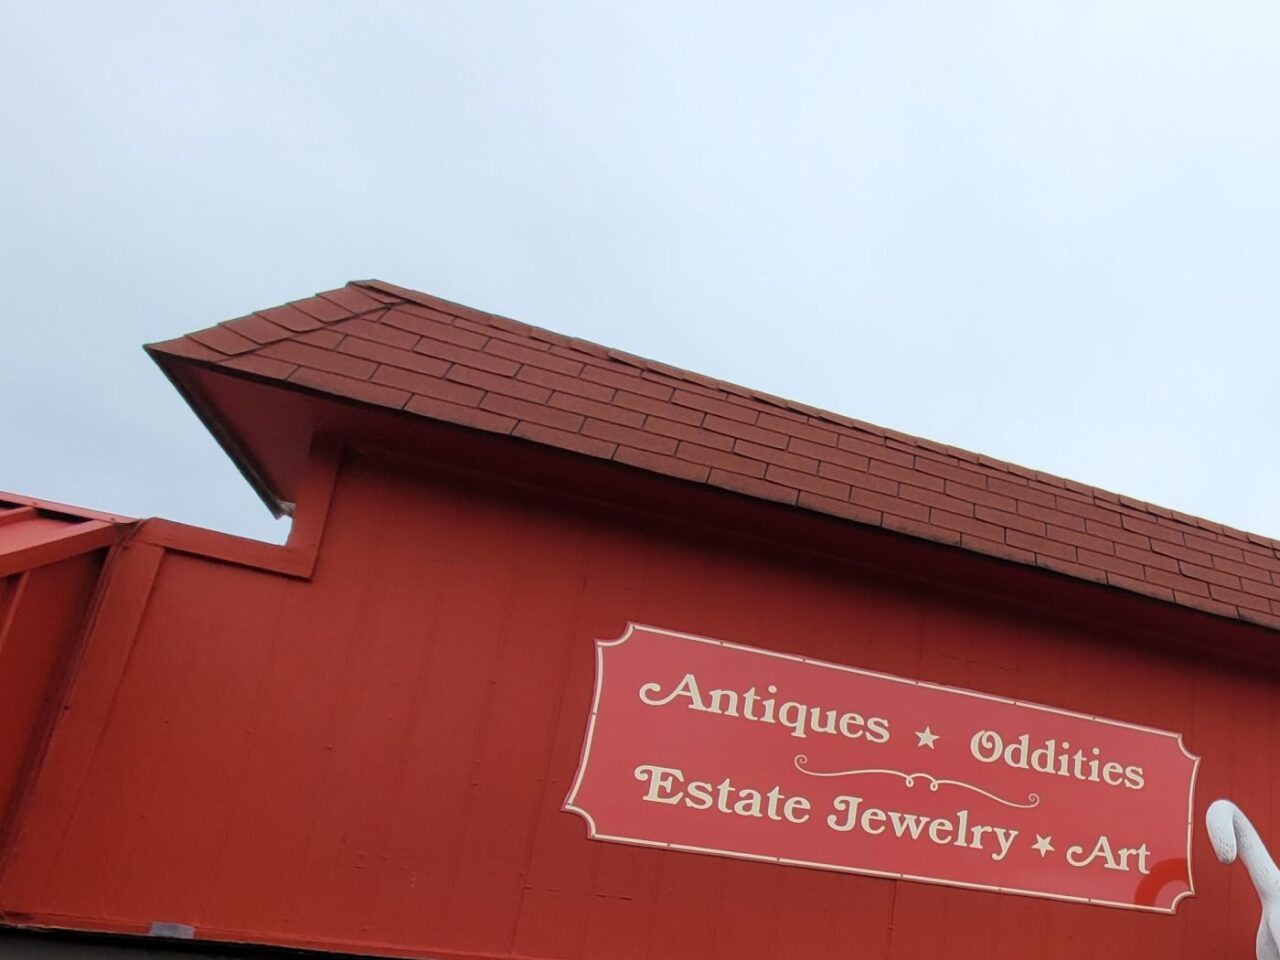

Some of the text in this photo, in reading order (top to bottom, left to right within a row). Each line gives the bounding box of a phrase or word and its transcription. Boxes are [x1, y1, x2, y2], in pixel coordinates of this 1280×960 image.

[639, 673, 1145, 790] Antiques Oddities
[634, 765, 1150, 874] Estate Jewelry Art
